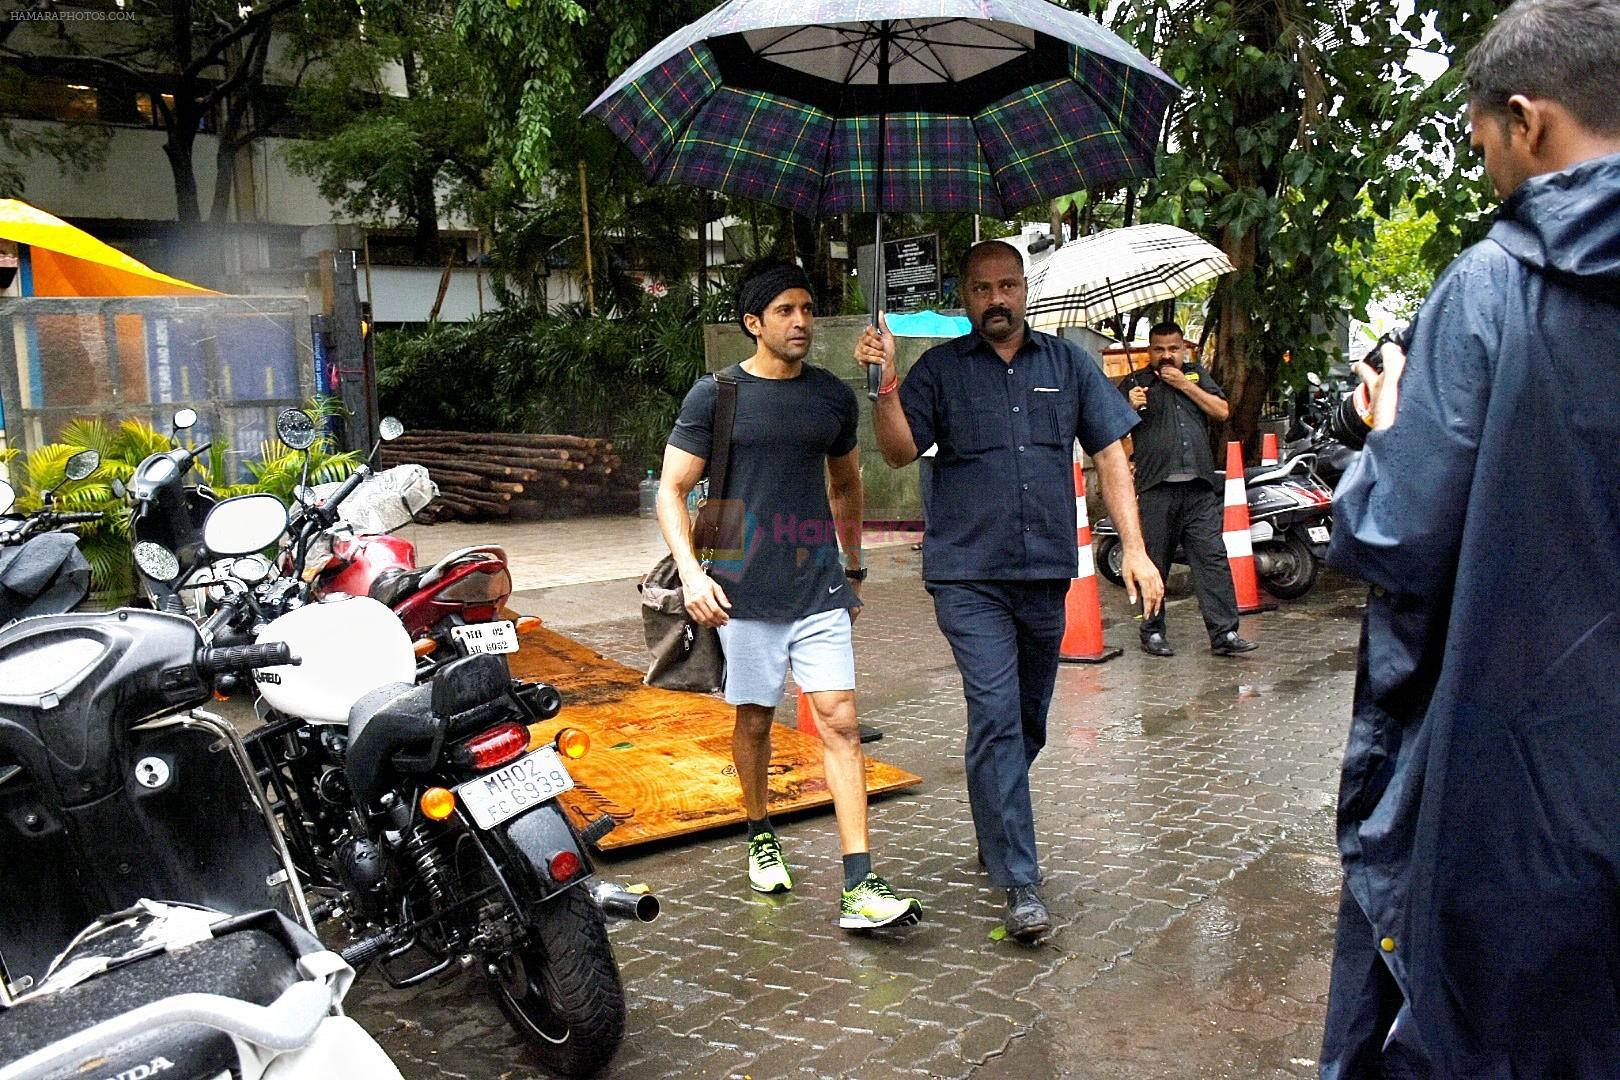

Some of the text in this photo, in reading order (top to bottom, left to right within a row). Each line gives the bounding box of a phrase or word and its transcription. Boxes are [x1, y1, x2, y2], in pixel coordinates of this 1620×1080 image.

[483, 759, 541, 796] MH02
[487, 770, 565, 821] FC 6939
[106, 1056, 175, 1080] NDA
